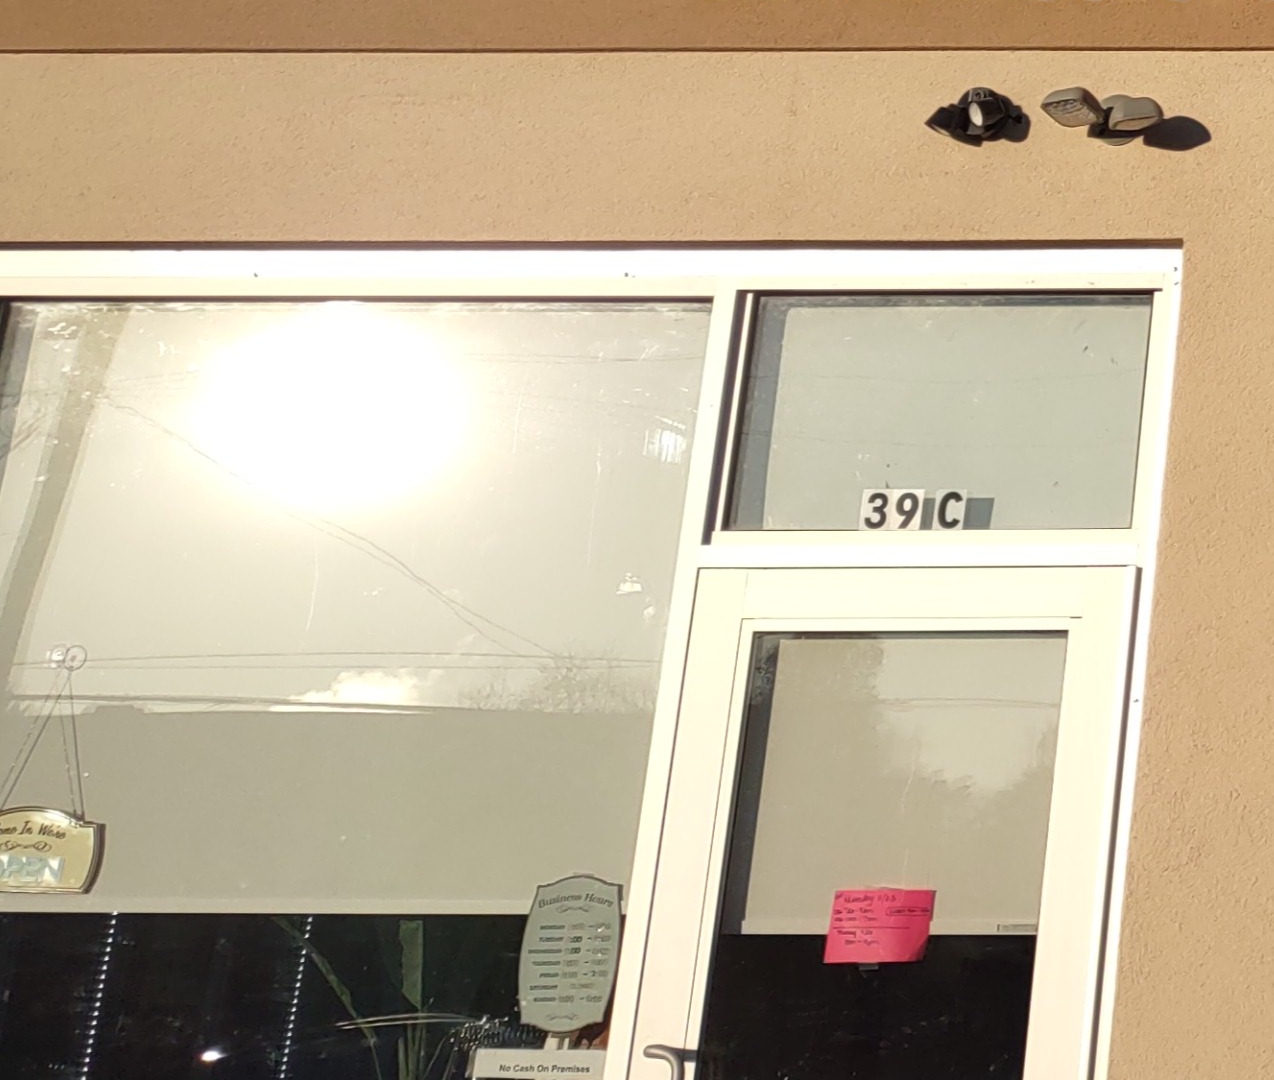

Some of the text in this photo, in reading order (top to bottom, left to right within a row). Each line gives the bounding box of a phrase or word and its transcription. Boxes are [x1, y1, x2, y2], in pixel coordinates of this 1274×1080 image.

[863, 490, 964, 530] 39 C
[537, 894, 583, 909] Business
[498, 1064, 591, 1074] No Cash On Premises
